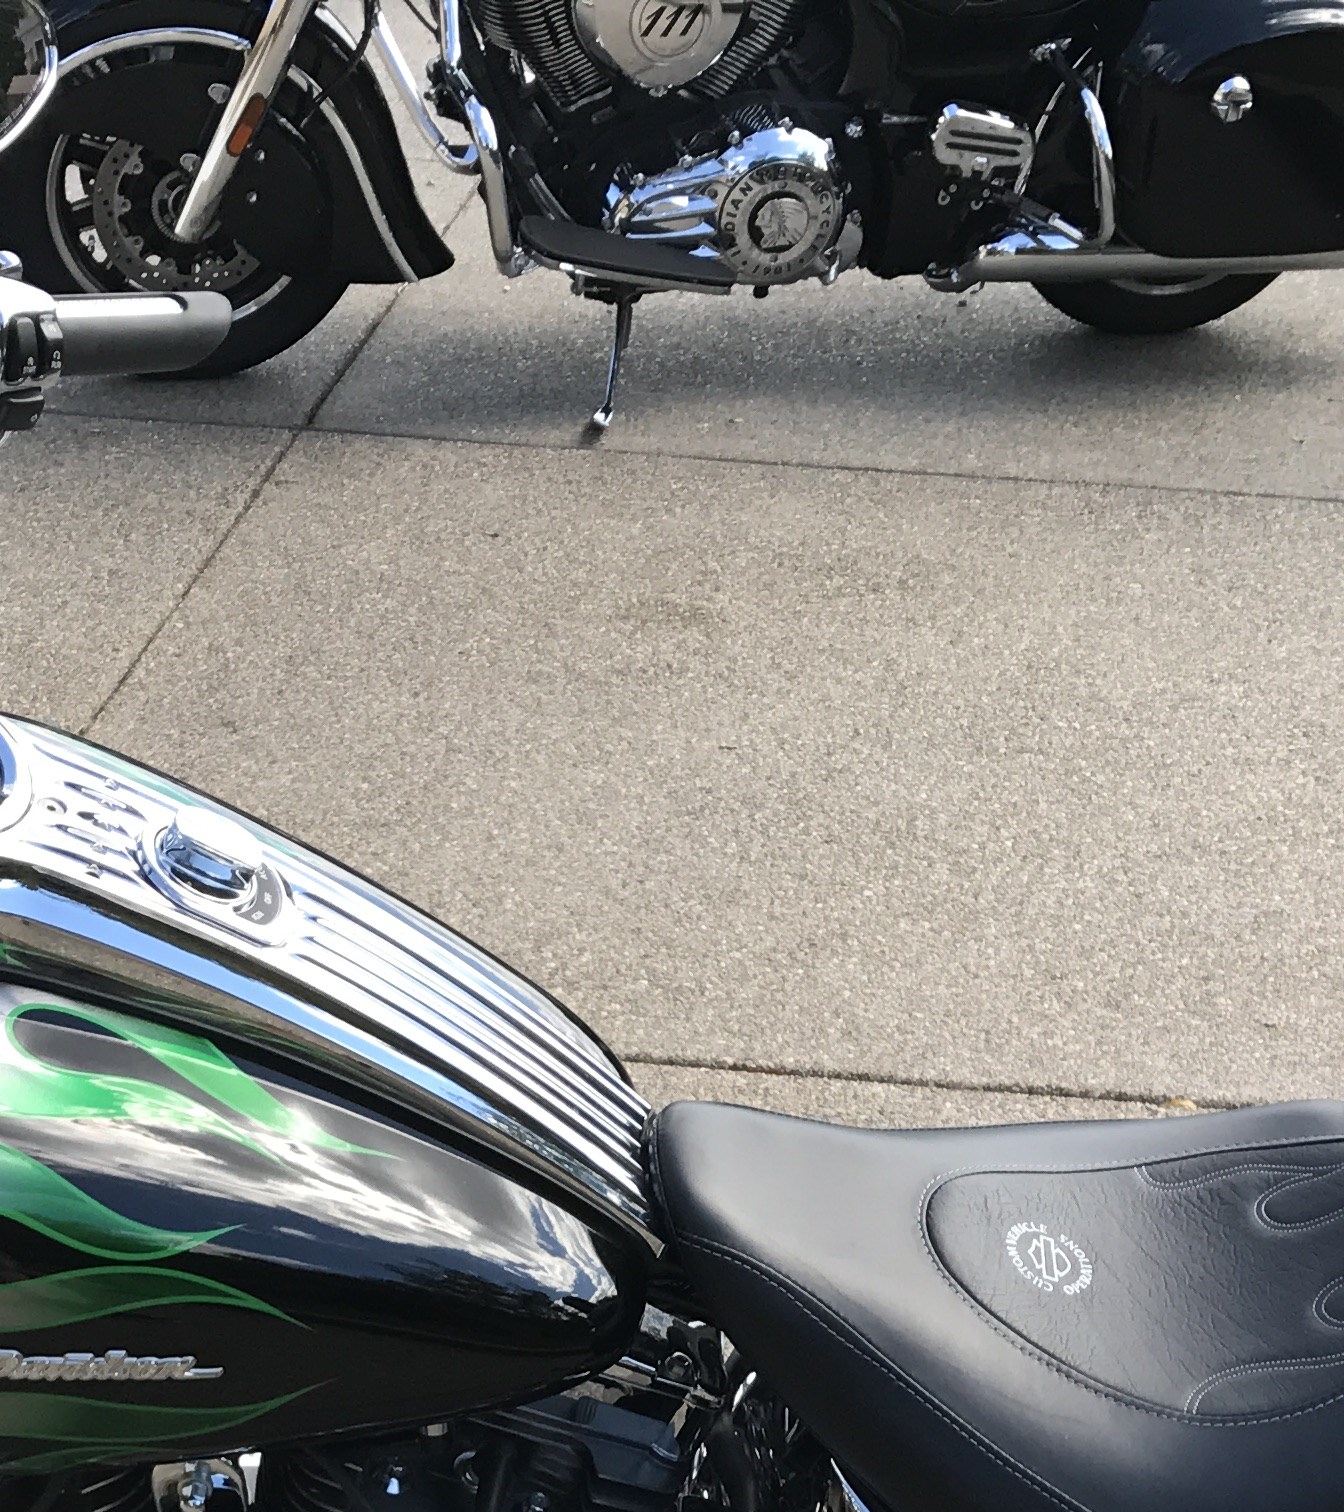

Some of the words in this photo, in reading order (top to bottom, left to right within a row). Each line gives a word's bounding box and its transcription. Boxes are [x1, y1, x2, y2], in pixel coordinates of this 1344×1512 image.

[640, 3, 704, 38] 111
[1006, 1221, 1048, 1247] VEHICLE
[1007, 1246, 1054, 1292] CUSTOM
[1059, 1233, 1093, 1296] OPERATIONS
